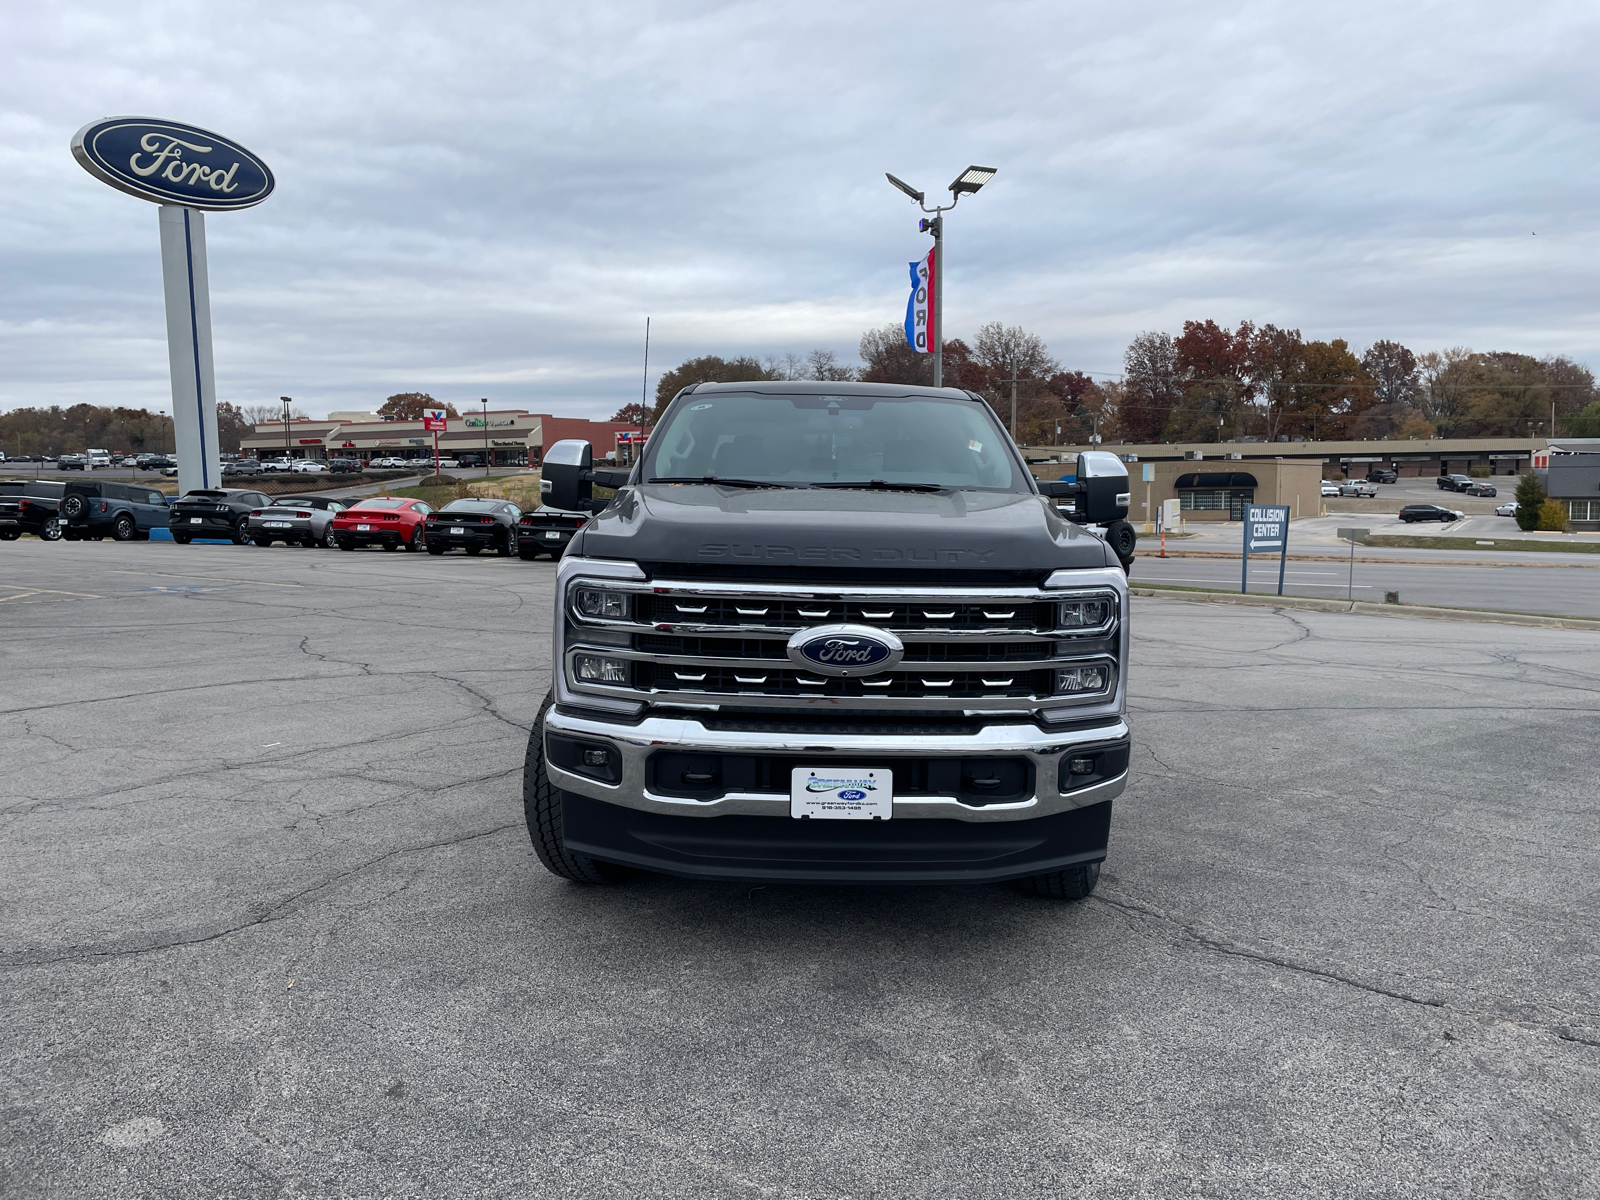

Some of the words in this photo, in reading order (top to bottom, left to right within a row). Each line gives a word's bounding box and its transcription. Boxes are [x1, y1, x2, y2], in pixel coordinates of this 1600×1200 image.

[130, 132, 240, 193] Ford
[1250, 508, 1285, 522] COLLISION
[1253, 523, 1280, 537] CENTER
[698, 543, 861, 560] SUPER
[873, 547, 996, 563] DUTY
[819, 639, 873, 661] Ford
[807, 777, 877, 788] GREENWAY
[843, 791, 861, 799] Ford
